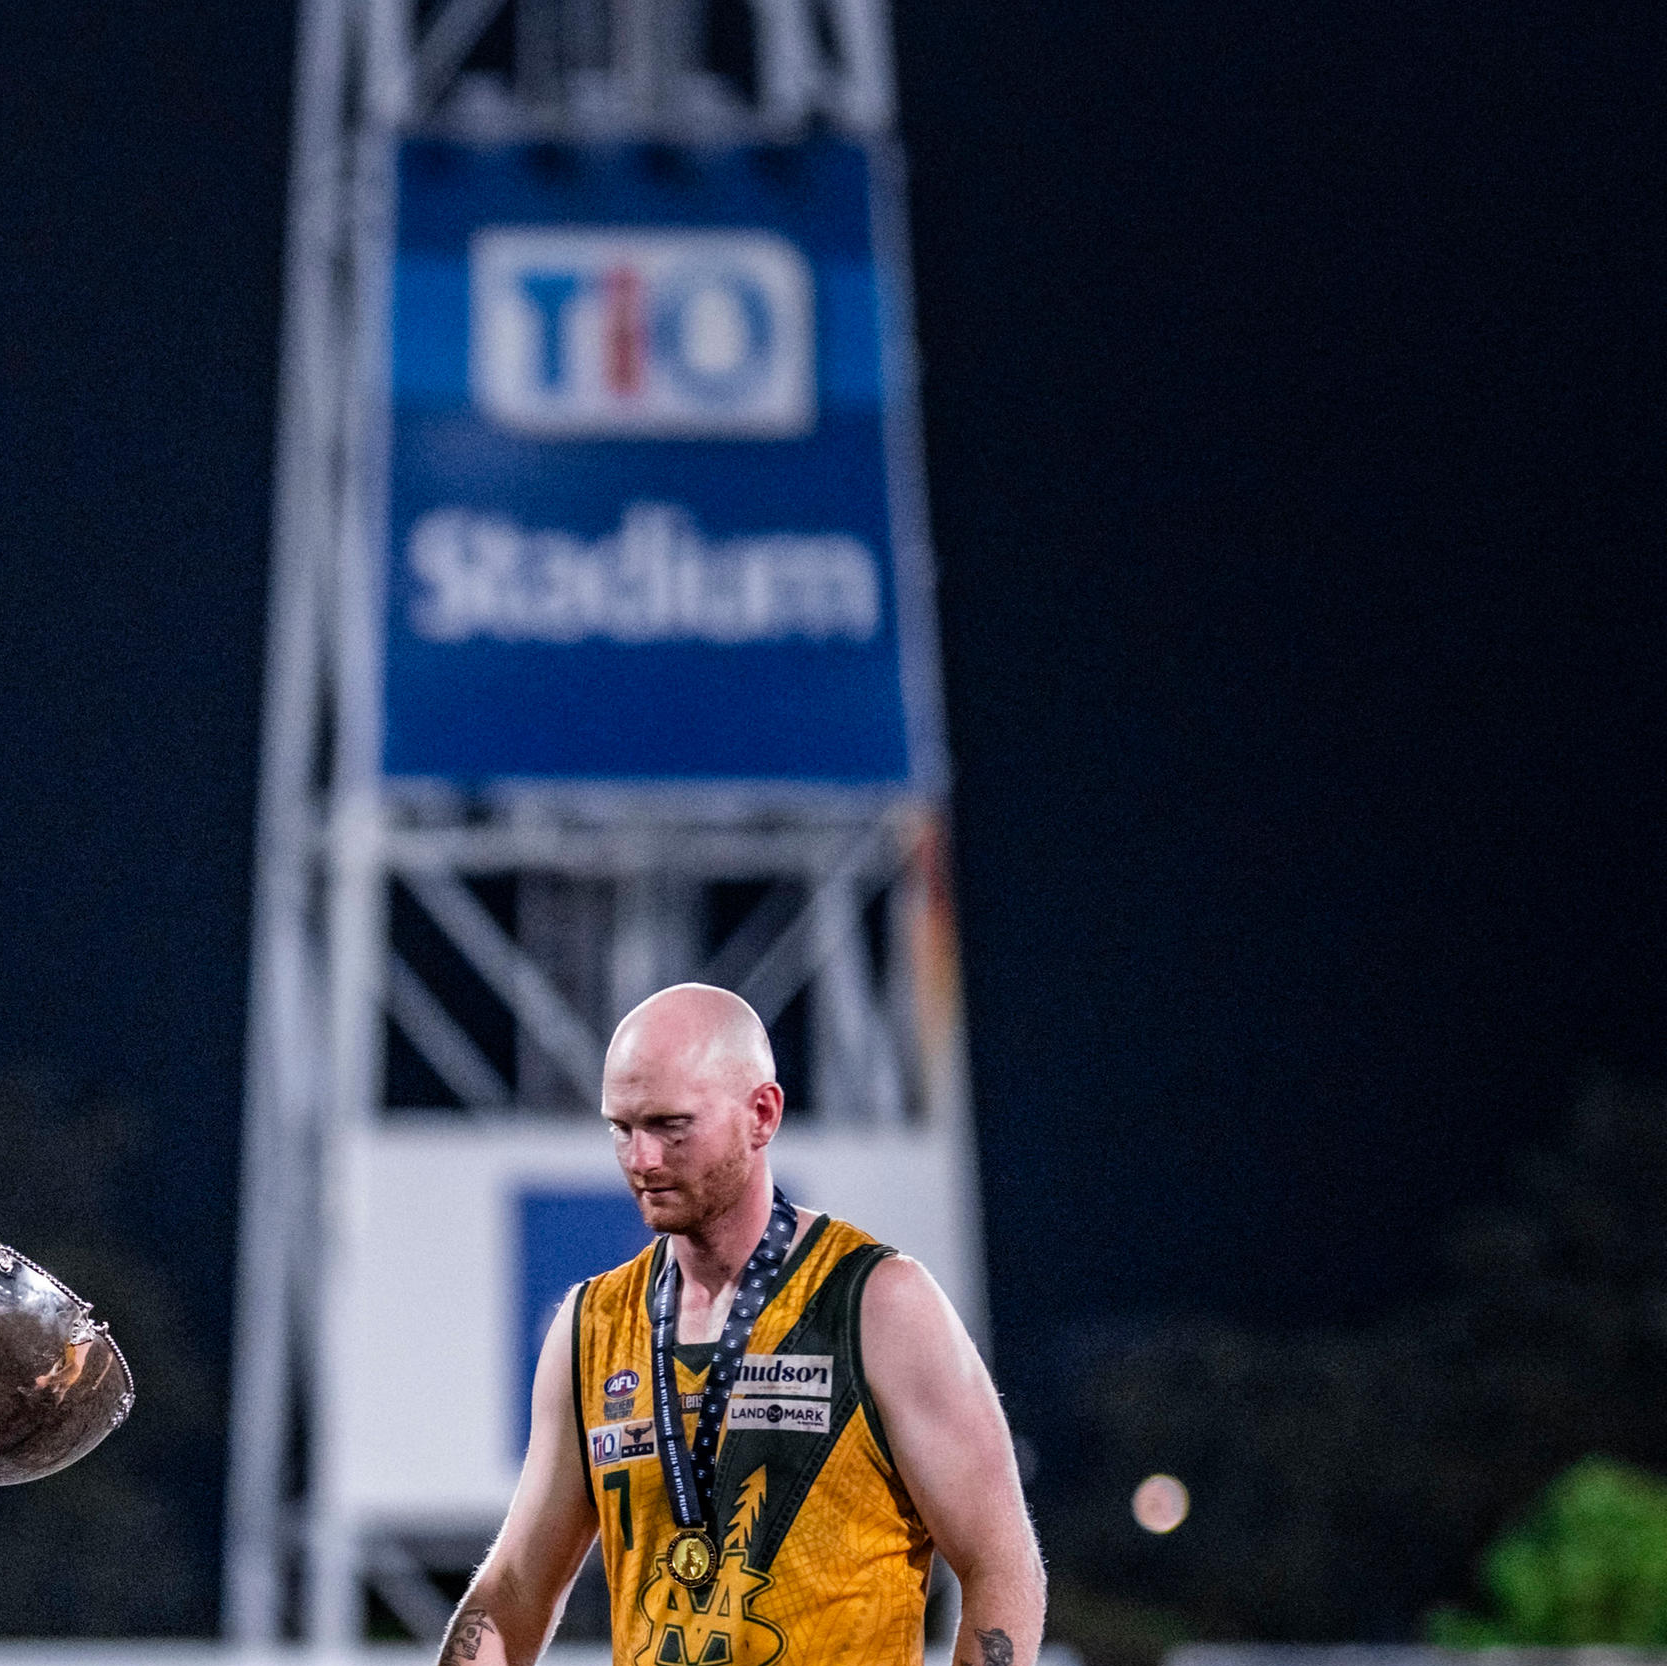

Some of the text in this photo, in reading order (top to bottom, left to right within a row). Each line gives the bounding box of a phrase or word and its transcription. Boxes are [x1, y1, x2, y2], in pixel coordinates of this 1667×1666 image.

[410, 503, 879, 642] Stadium
[608, 1374, 637, 1393] AFL
[662, 1405, 673, 1436] PREMIERS
[623, 1445, 653, 1454] NTFL
[679, 1494, 691, 1524] PREMIERS
